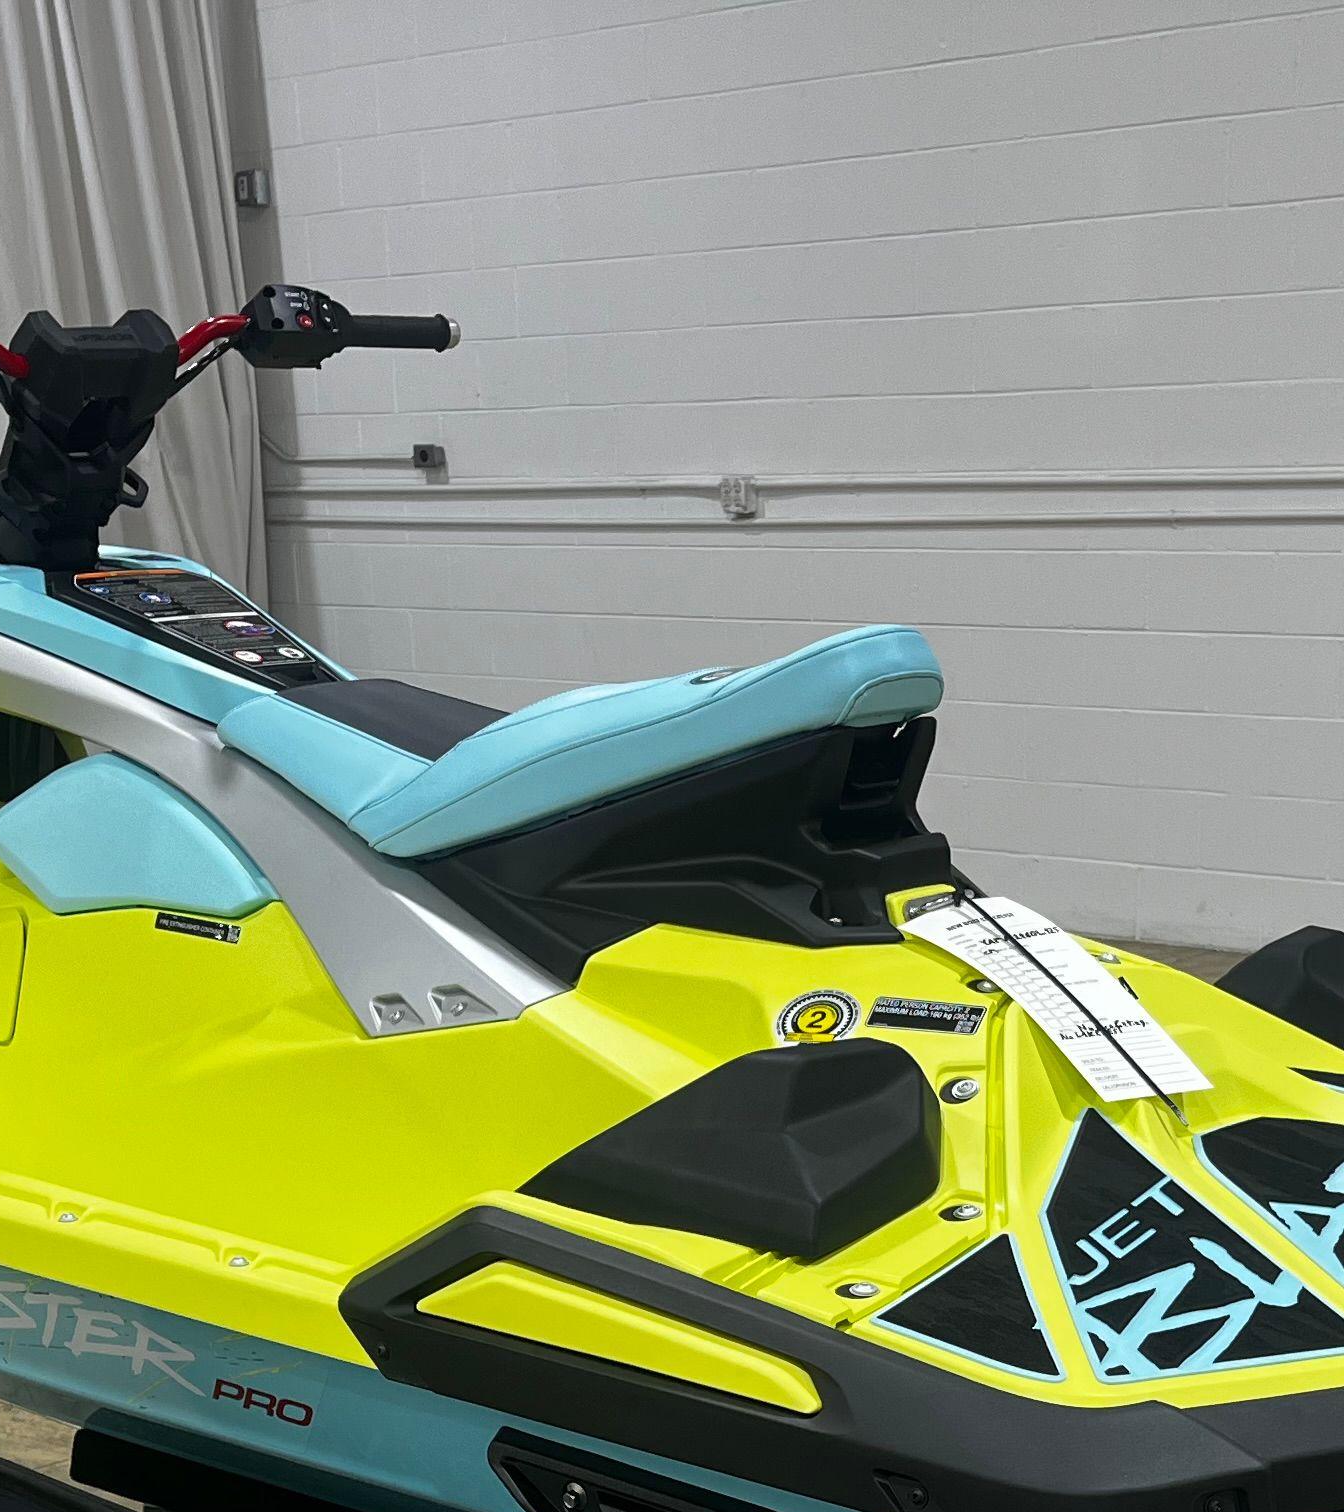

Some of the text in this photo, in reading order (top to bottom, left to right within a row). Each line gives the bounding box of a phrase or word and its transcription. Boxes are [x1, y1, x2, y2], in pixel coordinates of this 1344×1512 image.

[806, 1010, 827, 1029] 2
[1069, 1174, 1184, 1286] JET
[212, 1379, 314, 1427] PRO
